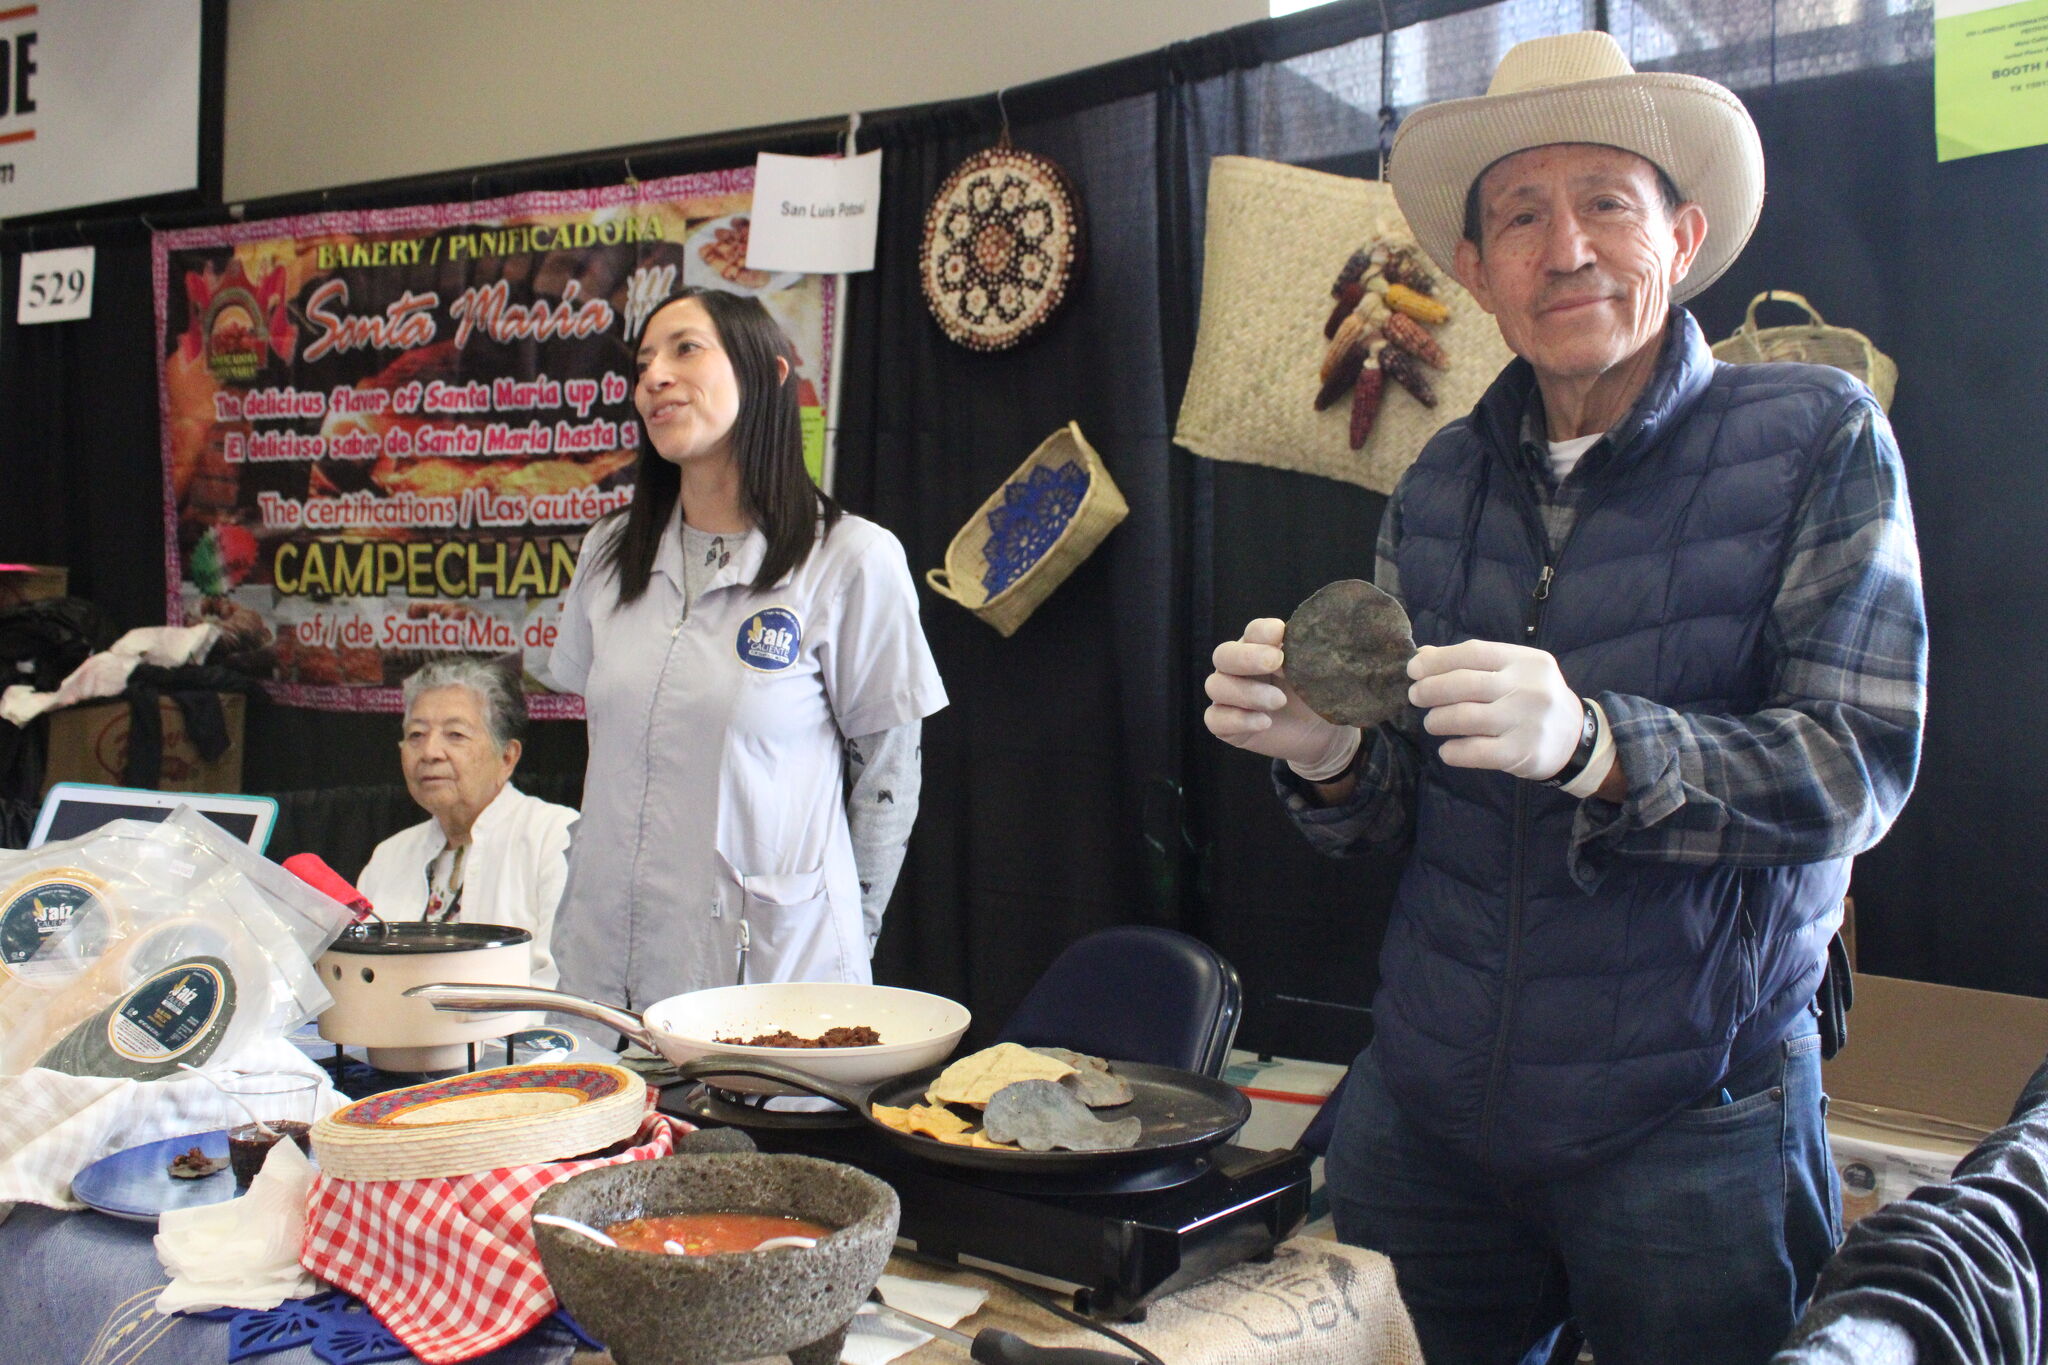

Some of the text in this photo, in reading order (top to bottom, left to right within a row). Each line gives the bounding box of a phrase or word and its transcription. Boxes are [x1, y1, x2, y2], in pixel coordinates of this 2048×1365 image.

[1991, 62, 2041, 80] BOOTH
[781, 201, 807, 217] San
[810, 203, 835, 218] Luis
[317, 215, 664, 270] BAKERY / PANIFICADORA
[28, 268, 86, 308] 529
[303, 278, 440, 361] Santa
[245, 388, 324, 417] delicious
[331, 385, 389, 414] flavor
[394, 382, 421, 412] of
[425, 381, 488, 410] Santa
[494, 374, 560, 409] María
[567, 379, 598, 416] up
[603, 372, 626, 403] to
[249, 430, 325, 459] delicioso
[330, 429, 380, 457] sabor
[386, 426, 411, 454] de
[416, 424, 480, 453] Santa
[556, 418, 616, 450] hasta
[259, 494, 299, 524] The
[306, 492, 458, 524] certifications
[478, 488, 526, 522] Las
[298, 614, 326, 642] of
[344, 614, 373, 643] de
[383, 615, 460, 647] Santa
[467, 616, 516, 647] Ma.
[524, 615, 559, 649] de
